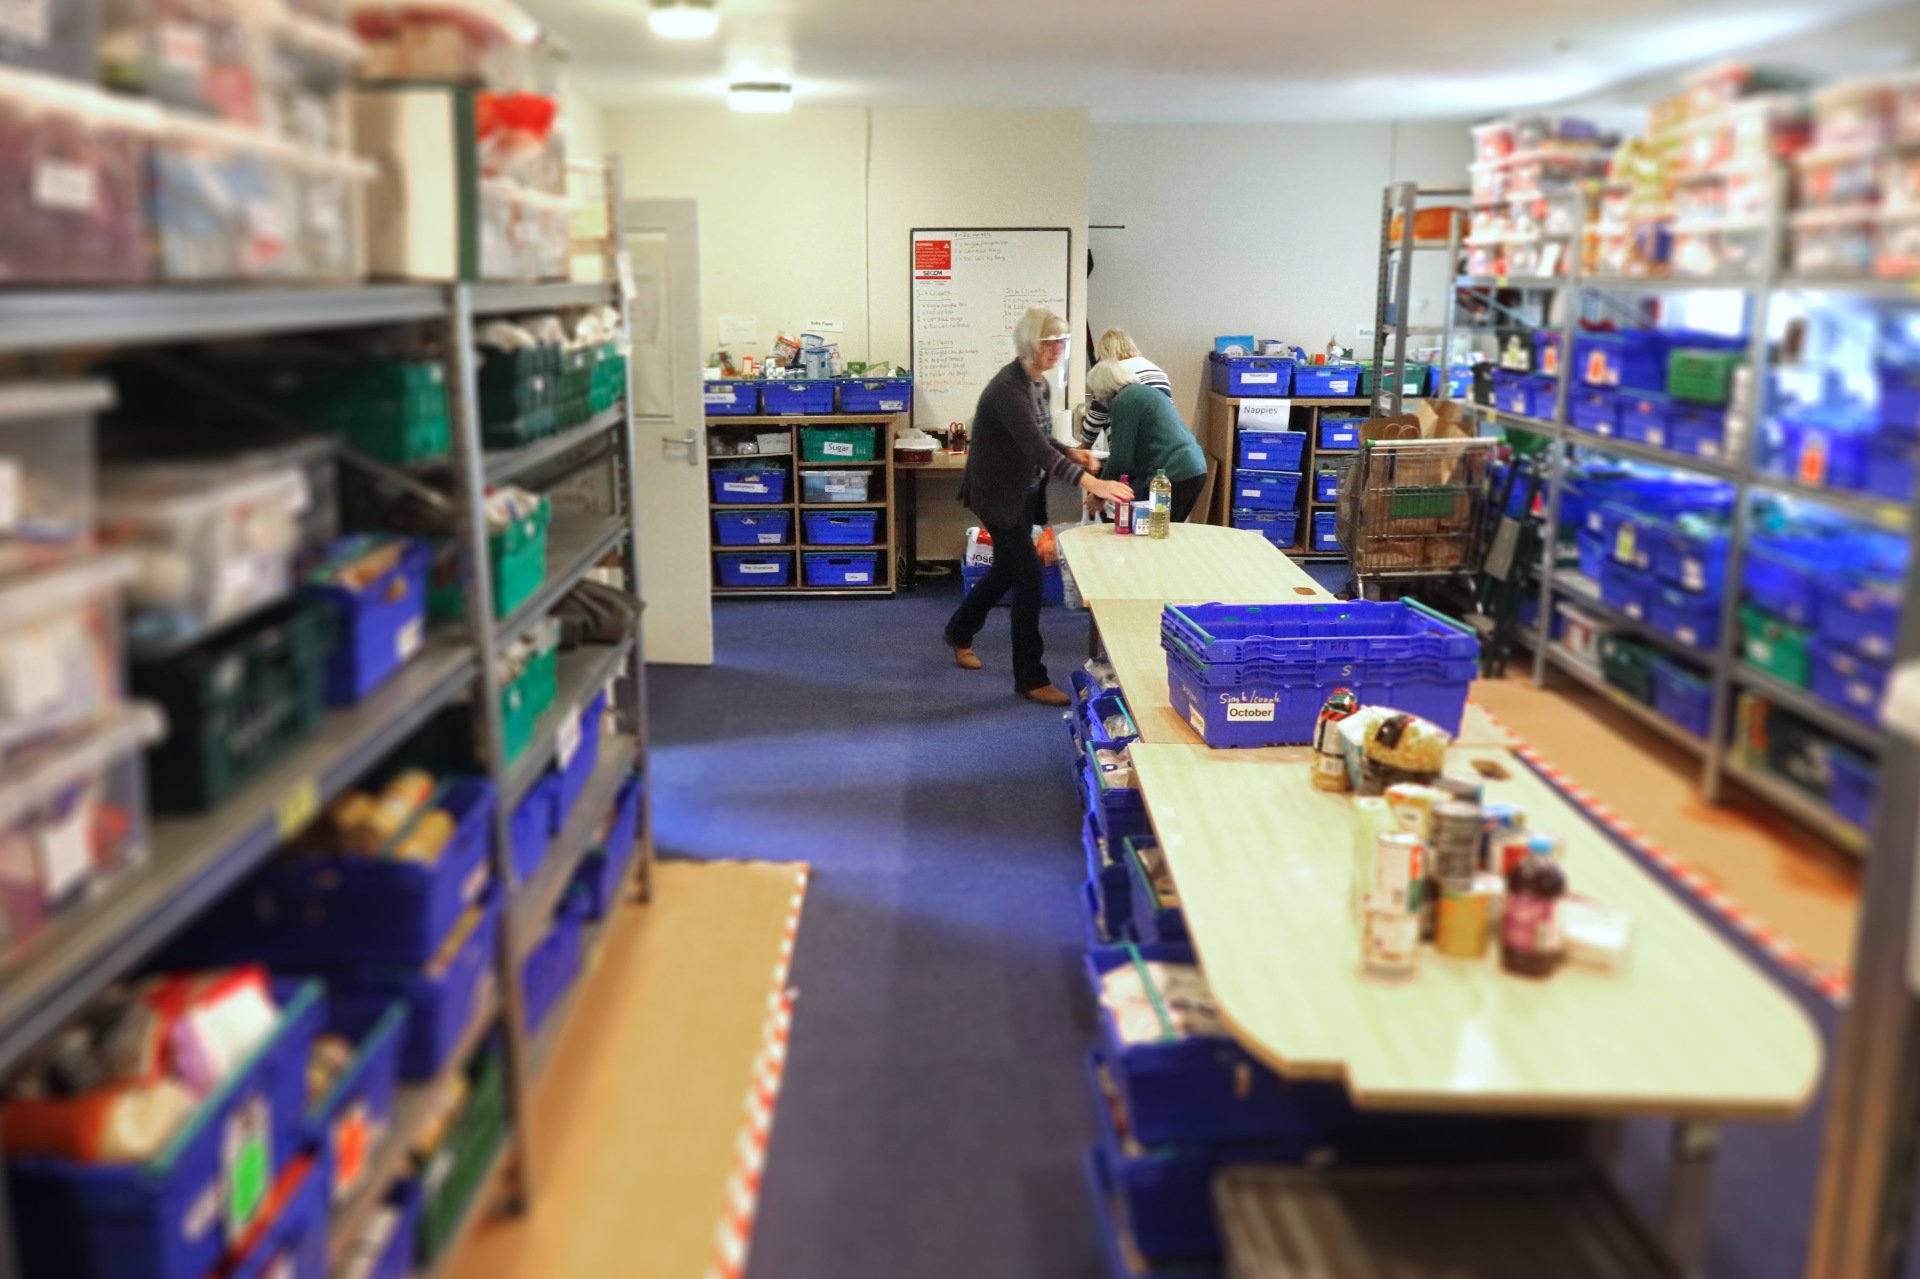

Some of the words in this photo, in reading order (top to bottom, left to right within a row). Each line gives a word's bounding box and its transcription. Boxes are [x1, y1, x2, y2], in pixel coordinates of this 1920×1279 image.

[1243, 406, 1277, 416] Nappies
[828, 443, 850, 452] Sugar
[1230, 708, 1272, 717] October
